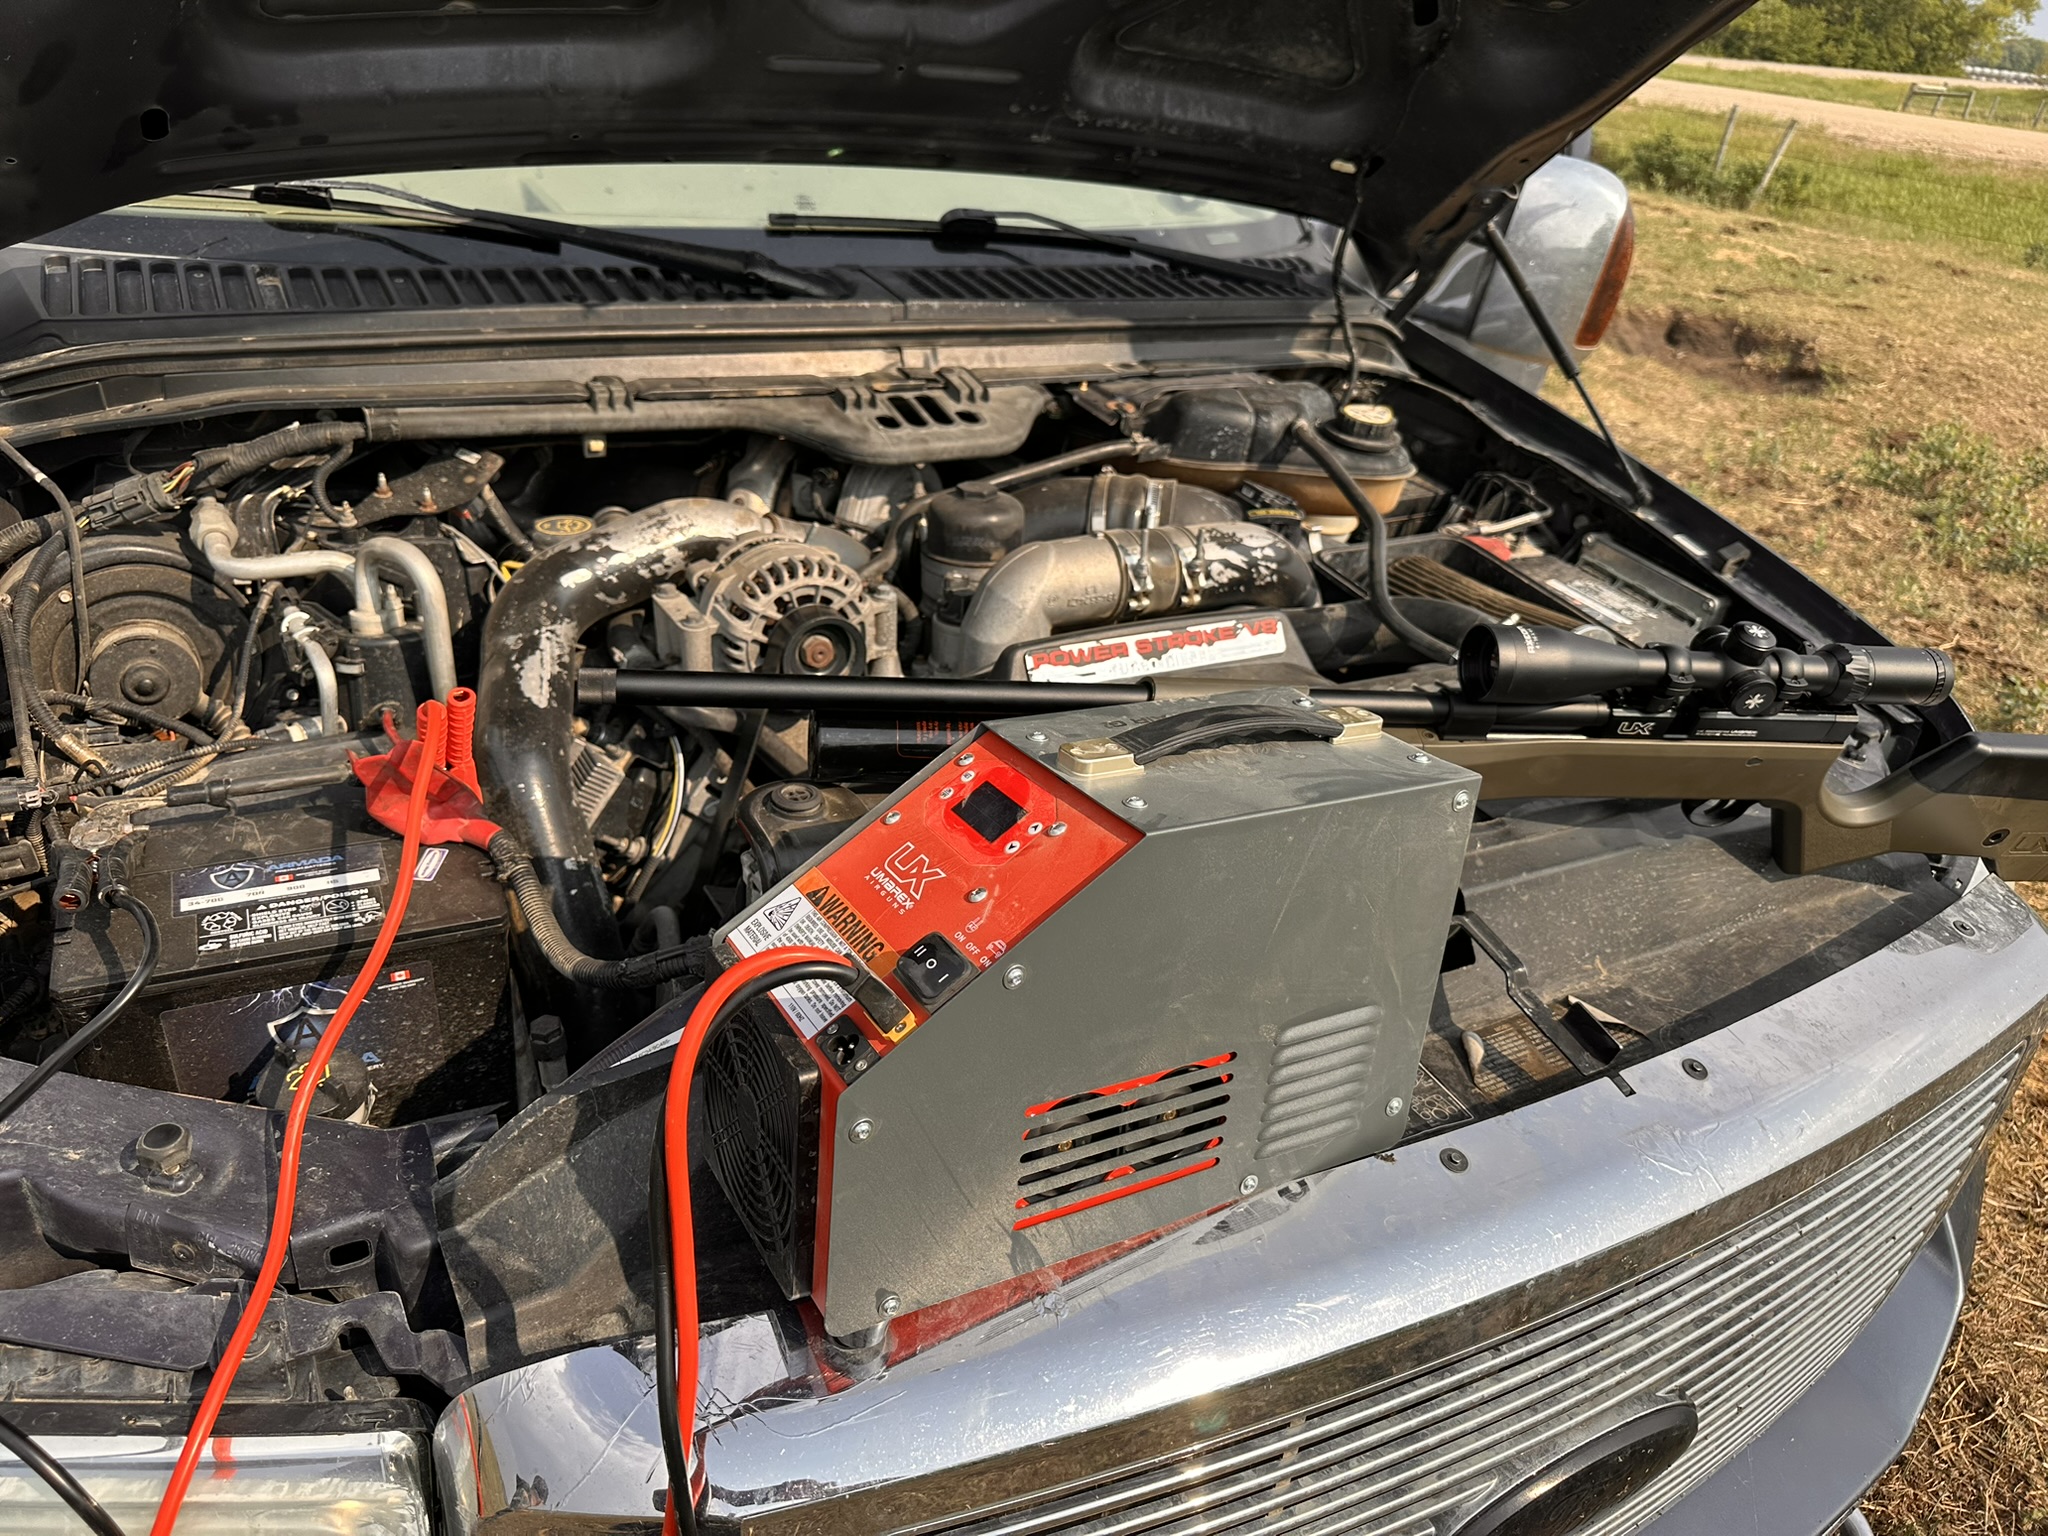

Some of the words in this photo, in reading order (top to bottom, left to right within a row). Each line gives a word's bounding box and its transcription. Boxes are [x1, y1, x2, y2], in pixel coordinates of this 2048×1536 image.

[1032, 641, 1130, 669] POWER
[1135, 624, 1238, 654] STROKE
[1244, 618, 1278, 637] V8
[266, 854, 345, 872] ARMADA
[884, 841, 947, 900] UX
[269, 889, 368, 909] DANGER/POISON
[864, 874, 906, 916] AIRGUNS
[744, 925, 763, 947] MATERIAL
[750, 918, 772, 941] EXPLOSIVE
[819, 894, 885, 963] WARNING
[954, 931, 967, 943] ON
[965, 942, 981, 955] OFF
[979, 955, 992, 968] ON
